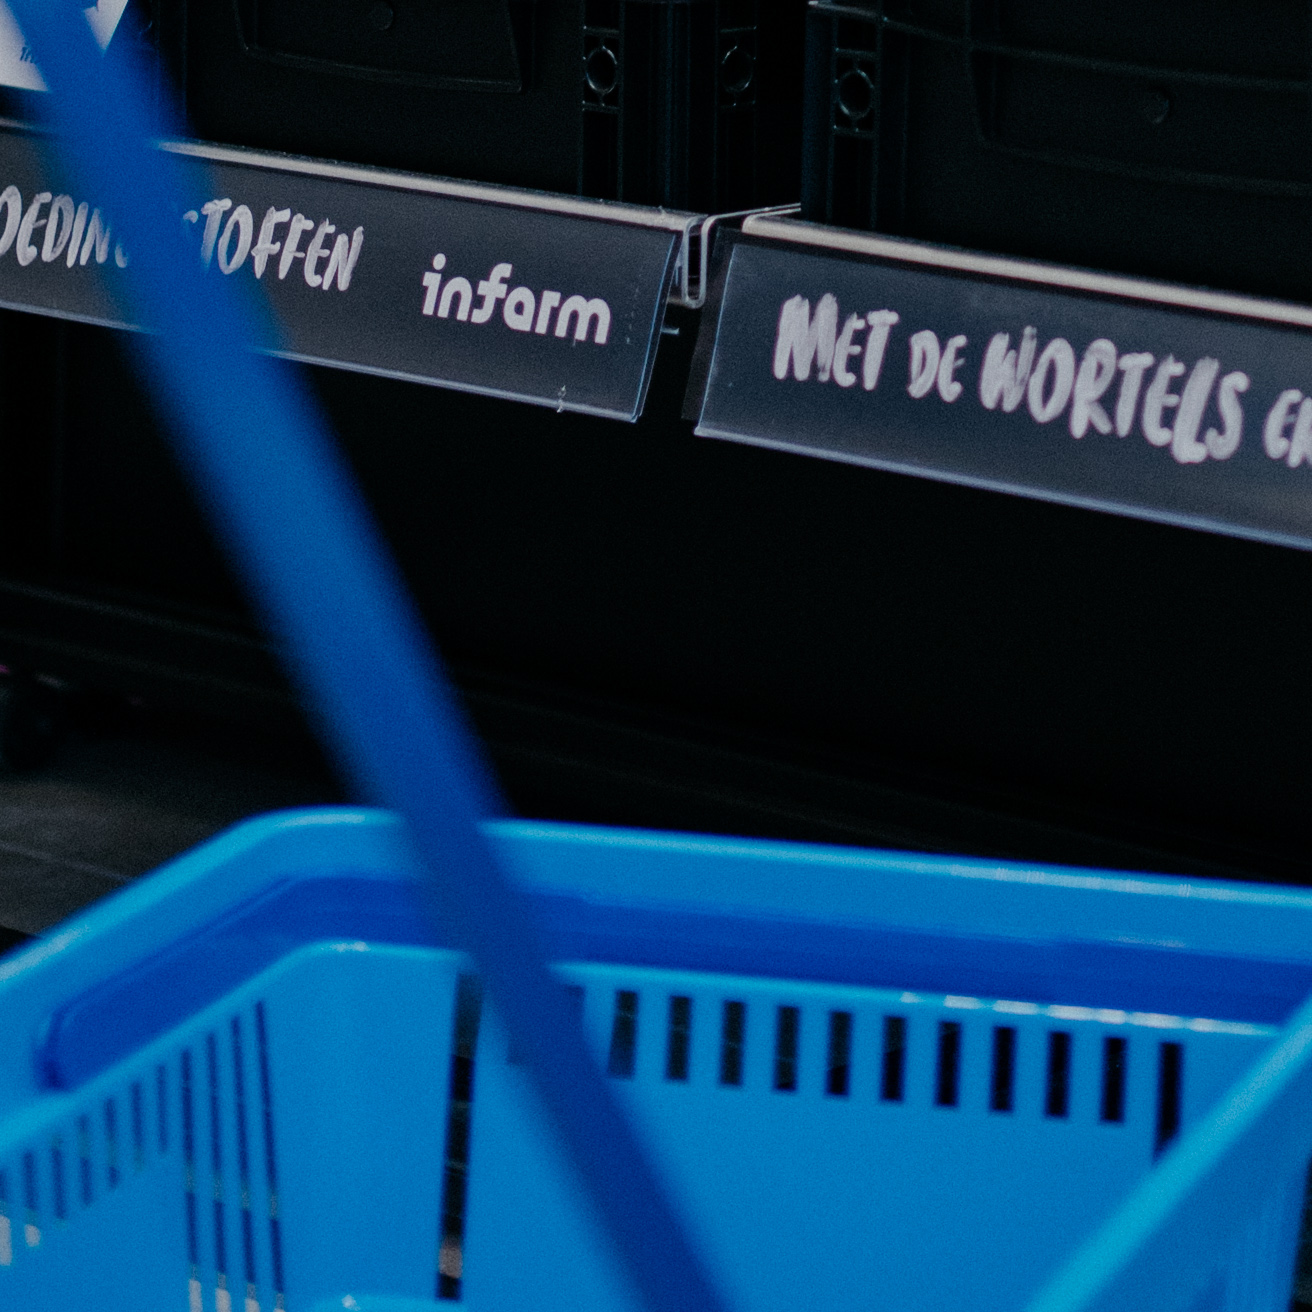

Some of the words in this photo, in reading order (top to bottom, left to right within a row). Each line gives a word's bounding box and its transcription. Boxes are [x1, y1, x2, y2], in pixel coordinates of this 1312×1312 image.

[422, 252, 612, 346] infarm
[772, 291, 900, 392] MET
[906, 328, 968, 404] DE
[979, 324, 1252, 465] WORTELS
